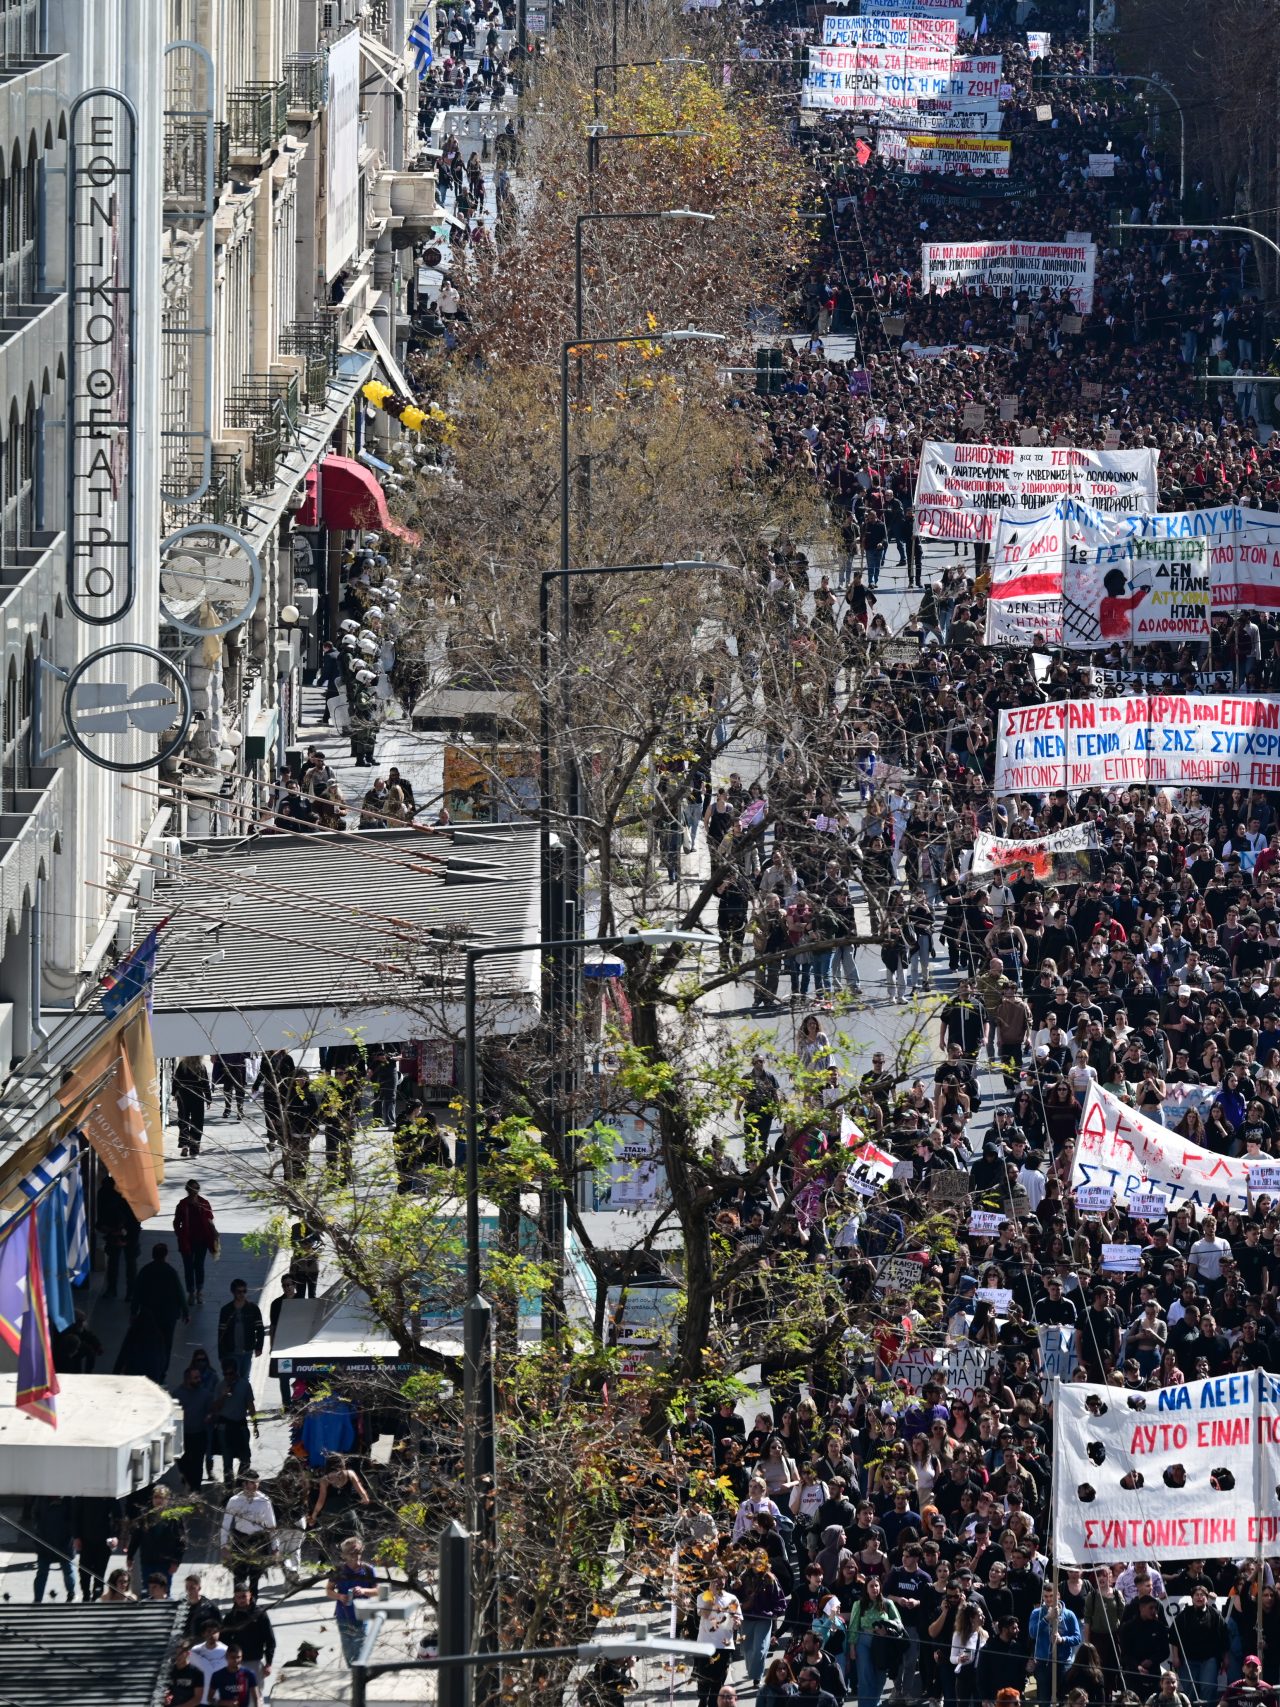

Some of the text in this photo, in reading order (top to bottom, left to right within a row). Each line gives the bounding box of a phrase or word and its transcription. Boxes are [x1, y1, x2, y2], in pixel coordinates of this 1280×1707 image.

[934, 20, 955, 32] ΟΡΓΗ
[819, 51, 833, 67] ΤΟ
[885, 55, 901, 69] ΣΤΑ
[977, 61, 996, 74] ΟΡΓΗ
[845, 74, 879, 89] ΚΕΡΔΗ
[885, 76, 914, 91] ΤΟΥΣ
[933, 79, 947, 94] ΜΕ
[951, 80, 963, 95] ΤΗ
[935, 464, 947, 475] ΝΑ
[951, 465, 1010, 480] ΑΝΑΤΡΕΨΟΥΜΕ
[86, 369, 115, 597] ΘΕΑΤΡΟ
[973, 493, 1016, 510] ΚΑΝΕΝΑΣ
[1125, 509, 1243, 538] ΣΥΓΚΑΛΥΨΗ
[1239, 545, 1267, 564] ΣΤΟΝ
[1155, 563, 1192, 578] ΔΕΝ
[1169, 576, 1211, 592] ΗΤΑΝΕ
[1007, 603, 1029, 614] ΔΕΝ
[1170, 604, 1206, 619] ΗΤΑΝ
[1016, 616, 1049, 628] ΗΤΑΝ
[1137, 618, 1211, 635] ΔΟΛΟΦΟΝΙΑ
[1005, 702, 1096, 737] ΣΤΕΡΕΨΑΝ
[1124, 696, 1192, 725] ΔΑΚΡΥΑ
[1220, 699, 1280, 730] ΕΓΙΝΑΝ
[1015, 738, 1025, 760] Η
[1034, 734, 1067, 758] ΝΕΑ
[1076, 733, 1121, 757] ΓΕΝΙΑ
[1134, 728, 1156, 751] ΔΕ
[1162, 728, 1197, 752] ΣΑΣ
[1004, 763, 1092, 790] ΣΥΝΤΟΝΙΣΤΙΚΗ
[1104, 757, 1167, 781] ΕΠΙΤΡΟΠΗ
[1180, 759, 1241, 785] ΜΑΘΗΤΩΝ
[893, 1365, 966, 1386] ΑΤΥΧΜΑ
[1158, 1386, 1192, 1412] ΝΑ
[1200, 1375, 1250, 1409] ΛΕΕΙ
[1130, 1423, 1188, 1455] ΑΥΤΟ
[1197, 1417, 1250, 1447] ΕΙΝΑΙ
[1083, 1518, 1236, 1549] ΣΥΝΤΟΝΙΣΤΙΚΗ
